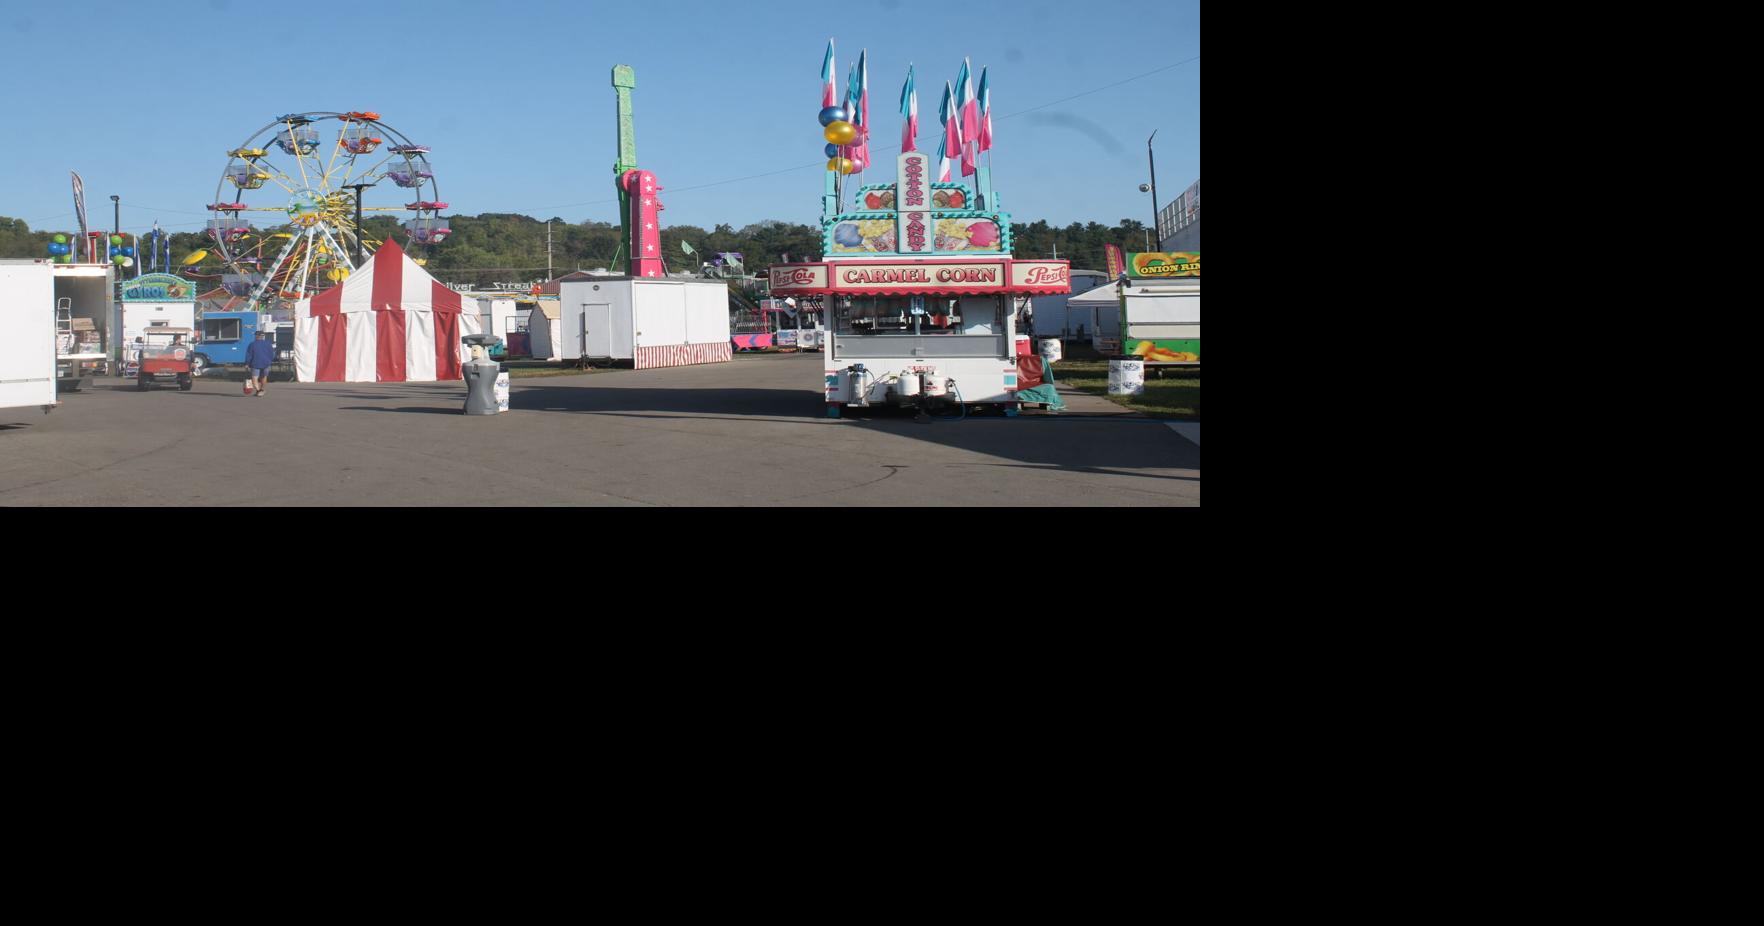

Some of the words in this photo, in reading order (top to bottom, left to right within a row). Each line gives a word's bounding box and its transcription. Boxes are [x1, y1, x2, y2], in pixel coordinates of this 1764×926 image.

[905, 156, 924, 206] COTTON
[906, 212, 925, 251] CANDY
[843, 268, 931, 283] CARMEL
[936, 267, 997, 283] CORN
[1140, 265, 1179, 275] ONION
[446, 281, 476, 292] ilver
